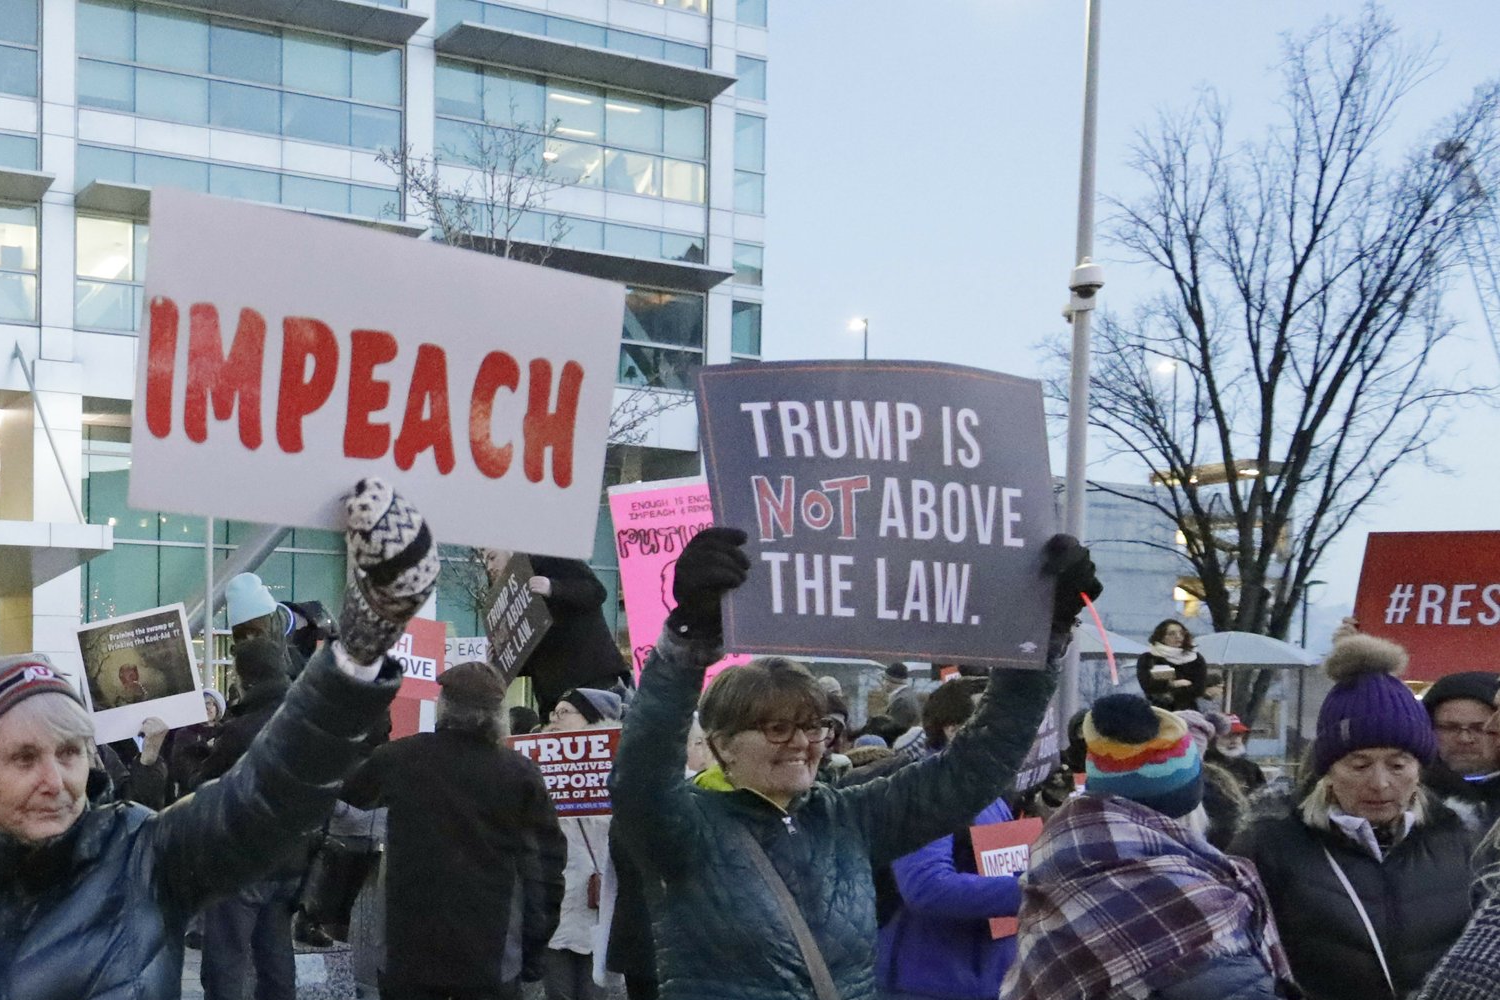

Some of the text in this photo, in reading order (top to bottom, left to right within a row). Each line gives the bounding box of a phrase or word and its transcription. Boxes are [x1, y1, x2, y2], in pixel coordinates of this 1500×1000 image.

[145, 295, 584, 488] IMPEACH
[740, 400, 981, 468] TRUMP IS
[629, 509, 675, 520] IMPEACH
[631, 499, 668, 511] ENOUGH
[675, 497, 683, 505] IS
[879, 477, 1024, 547] ABOVE
[487, 586, 509, 631] TRUMP
[508, 573, 519, 596] IS
[506, 583, 533, 630] ABOVE
[761, 552, 980, 625] THE LAW.
[1384, 583, 1500, 626] #RES
[499, 641, 517, 672] THE
[514, 734, 611, 762] TRUE
[572, 790, 587, 799] OF
